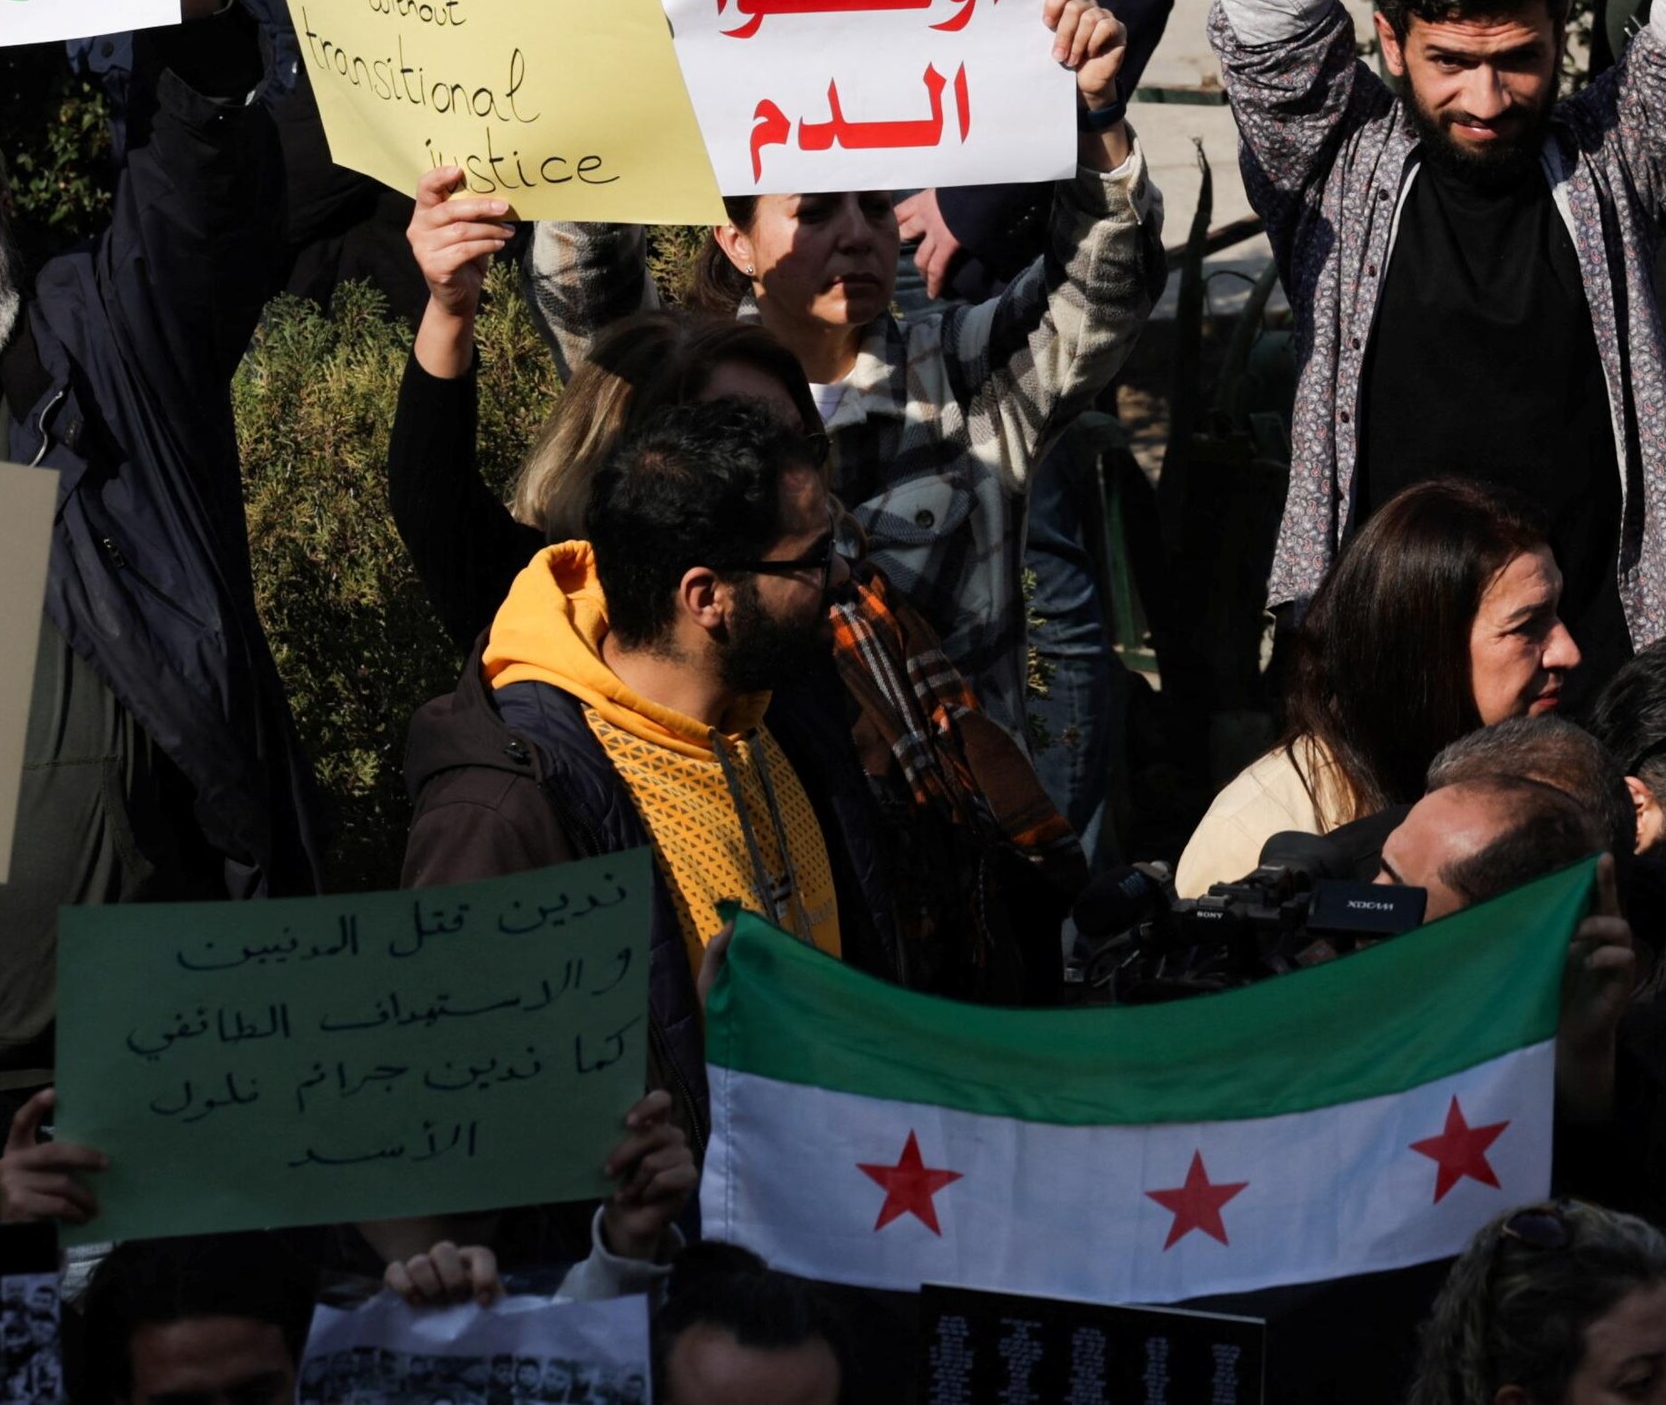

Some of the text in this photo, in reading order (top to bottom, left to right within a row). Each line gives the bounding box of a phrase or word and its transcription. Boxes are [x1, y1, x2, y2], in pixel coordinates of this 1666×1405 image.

[302, 5, 541, 124] transitional
[749, 60, 971, 185] الدم
[176, 872, 629, 972] ندين قتل المدنيين
[424, 1048, 543, 1092] ندين
[573, 1016, 643, 1076] كما
[287, 1122, 478, 1169] الأسد
